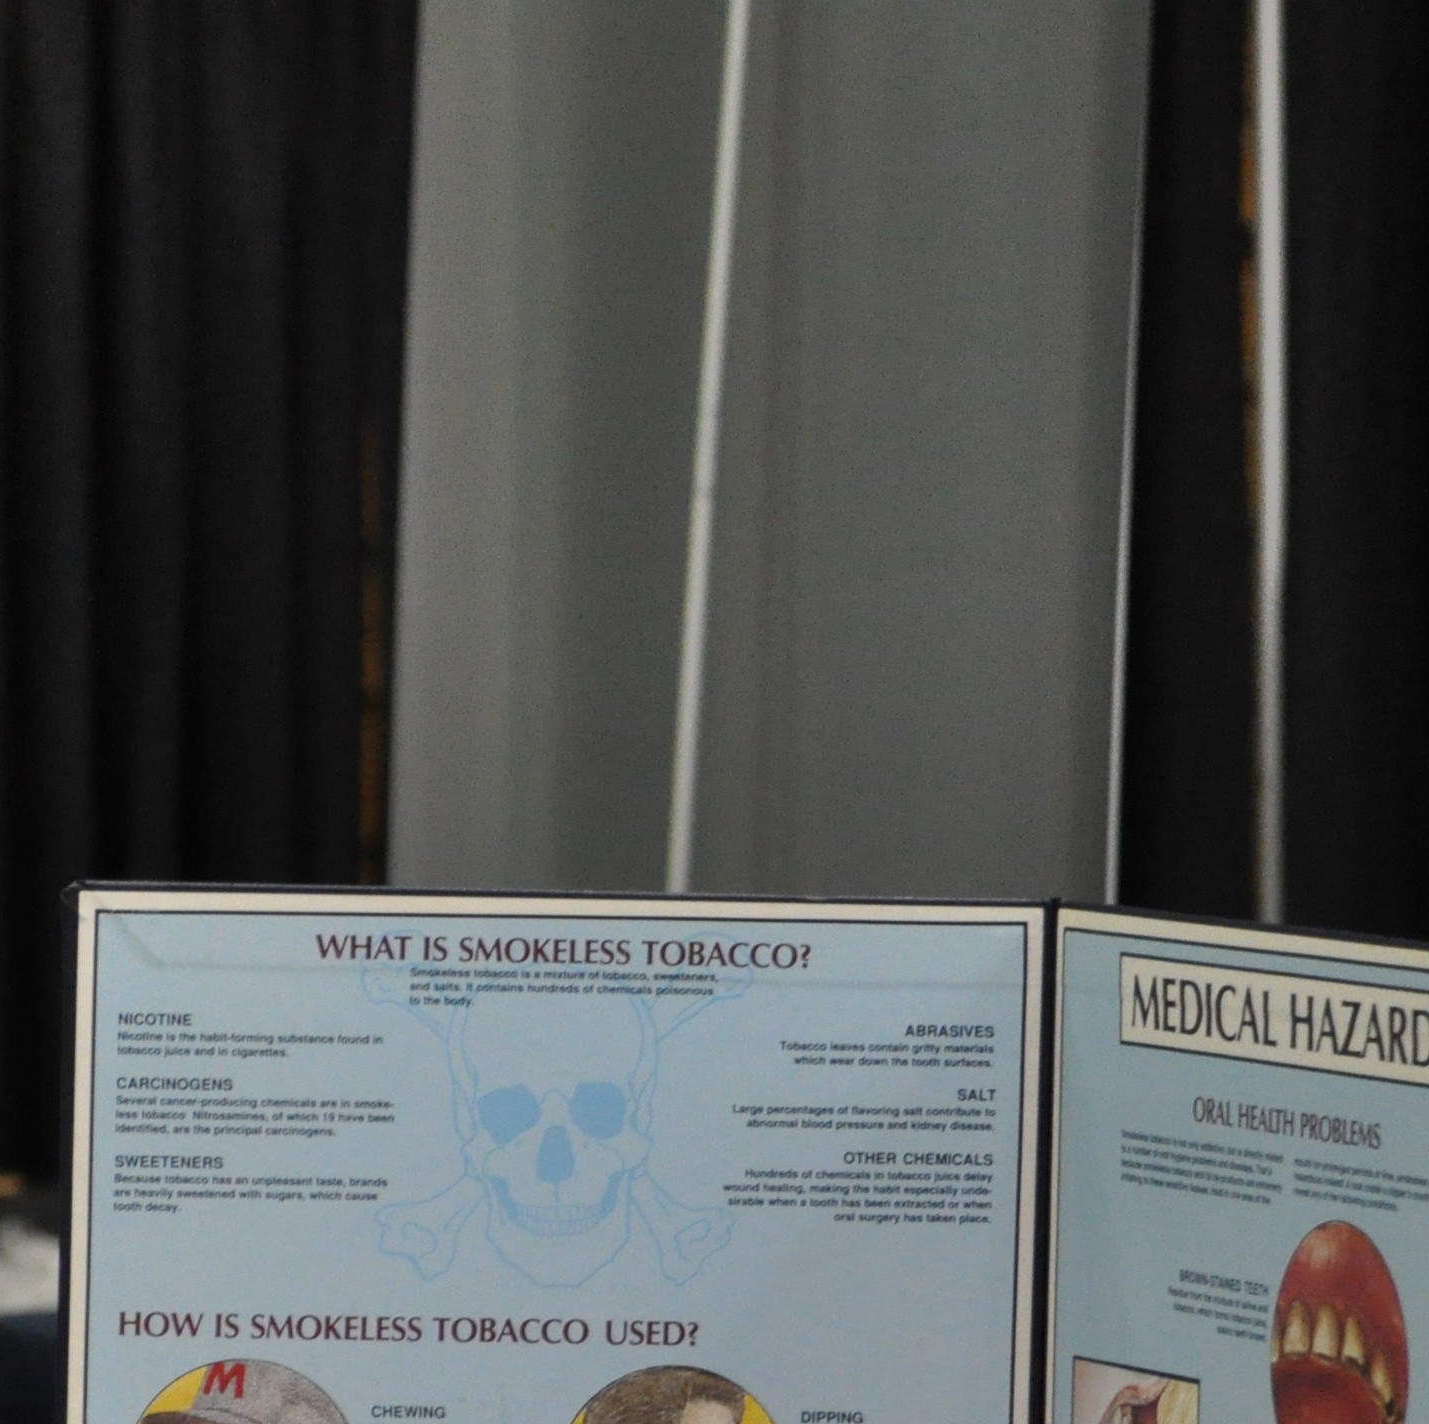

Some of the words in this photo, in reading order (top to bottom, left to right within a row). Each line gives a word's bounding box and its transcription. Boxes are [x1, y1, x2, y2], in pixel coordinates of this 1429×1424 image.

[315, 933, 412, 962] WHAT
[423, 935, 449, 962] IS
[458, 936, 631, 965] SMOKELESS
[642, 940, 811, 969] TOBACCO?
[1131, 974, 1277, 1048] MEDICAL
[117, 1013, 192, 1027] NICOTINE
[166, 1032, 176, 1042] is
[179, 1033, 197, 1042] the
[372, 1035, 383, 1044] in
[905, 1025, 995, 1039] ABRASIVES
[858, 1057, 888, 1066] down
[891, 1058, 909, 1066] the
[116, 1077, 233, 1091] CARCINOGENS
[957, 1089, 997, 1102] SALT
[1192, 1096, 1234, 1127] ORAL
[1238, 1103, 1294, 1137] HEALTH
[1300, 1112, 1381, 1150] PROBLEMS
[114, 1155, 223, 1169] SWEETENERS
[843, 1152, 897, 1166] OTHER
[903, 1153, 993, 1166] CHEMICALS
[118, 1311, 204, 1337] HOW
[214, 1312, 240, 1339] IS
[249, 1314, 422, 1342] SMOKELESS
[433, 1317, 589, 1345] TOBACCO
[605, 1320, 699, 1346] USED?
[203, 1361, 245, 1398] M
[371, 1405, 446, 1419] CHEWING
[800, 1411, 863, 1424] DIPPING
